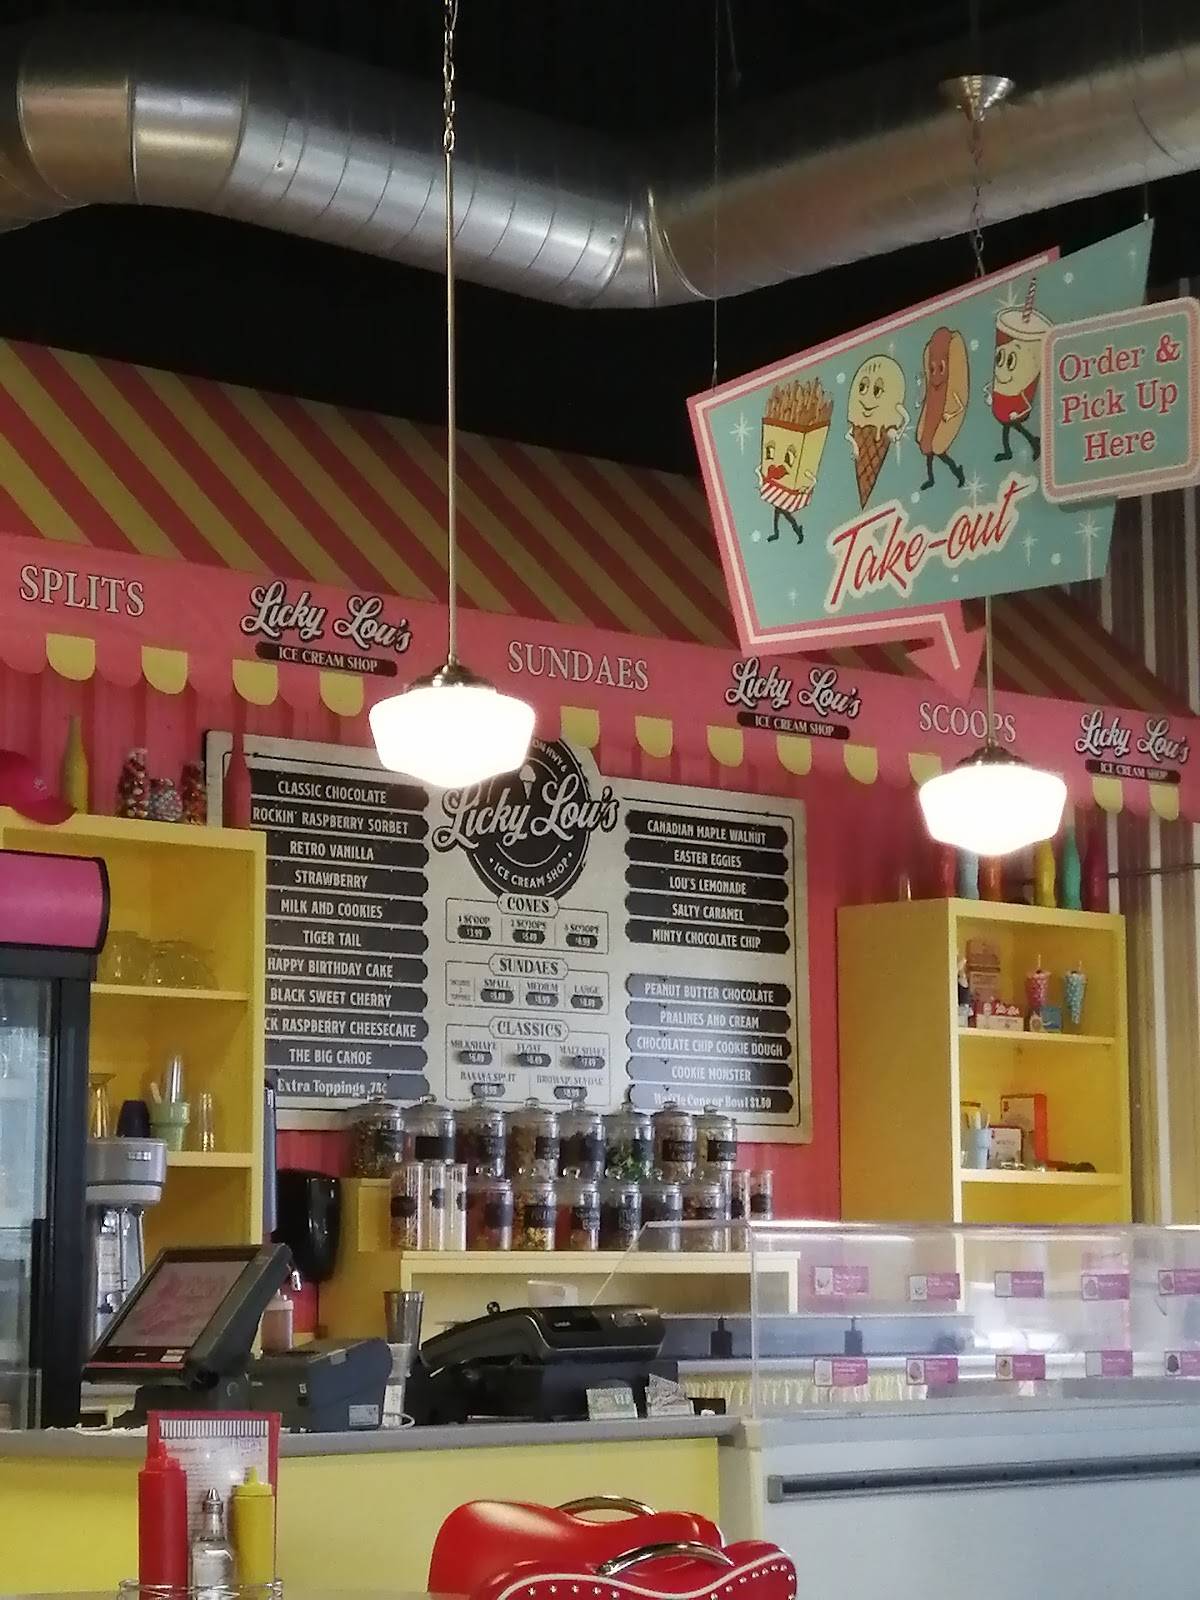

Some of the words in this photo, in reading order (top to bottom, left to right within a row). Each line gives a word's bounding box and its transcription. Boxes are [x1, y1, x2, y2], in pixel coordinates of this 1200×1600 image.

[1058, 344, 1145, 383] Order
[1155, 334, 1181, 363] &
[1061, 388, 1126, 424] Pick
[1136, 379, 1179, 414] Up
[1084, 430, 1156, 462] Here
[827, 478, 1033, 609] Take-out
[19, 564, 145, 617] SPLITS
[240, 580, 328, 641] Licky
[332, 595, 413, 653] Lou's
[279, 647, 298, 660] ICE
[302, 650, 344, 667] CREAM
[347, 657, 378, 673] SHOP
[508, 641, 648, 691] SUNDAES
[725, 657, 793, 709] Licky
[797, 668, 862, 718] Lou's
[755, 715, 769, 727] ICE
[773, 718, 808, 732] CREAM
[809, 723, 834, 737] SHOP
[919, 701, 1017, 743] SCOOPS
[1074, 709, 1131, 759] Licky
[1136, 718, 1190, 764] Lou's
[1100, 762, 1113, 773] ICE
[1115, 763, 1146, 778] CREAM
[1146, 767, 1168, 780] SHOP
[278, 781, 322, 798] CLASSIC
[325, 786, 387, 804] CHOCOLATE
[252, 807, 298, 823] ROCKIN'
[302, 812, 364, 830] RASPBERRY
[368, 818, 409, 835] SORBET
[432, 784, 531, 852] Licky
[530, 773, 619, 841] Lou's
[647, 820, 694, 837] CANADIAN
[697, 826, 727, 840] MAPLE
[730, 829, 767, 845] WALNUT
[289, 841, 326, 856] RETRO
[330, 844, 374, 861] VANILLA
[674, 849, 708, 865] EASTER
[711, 852, 742, 868] EGGIES
[295, 869, 368, 888] STRAWBERRY
[493, 862, 509, 880] ICE
[511, 874, 545, 888] CREAM
[546, 857, 569, 882] SHOP
[669, 876, 696, 890] LOU'S
[699, 879, 746, 895] LEMONADE
[281, 899, 307, 914] MILK
[311, 901, 334, 916] AND
[337, 903, 383, 919] COOKIES
[507, 896, 550, 913] CONES
[672, 903, 699, 918] SALTY
[702, 906, 745, 921] CARAMEL
[464, 915, 490, 925] SCOOP
[303, 930, 335, 945] TIGER
[338, 932, 362, 947] TAIL
[652, 928, 682, 942] MINTY
[685, 931, 737, 947] CHOCOLATE
[740, 935, 761, 949] CHIP
[267, 957, 305, 972] HAPPY
[308, 961, 362, 976] BIRTHDAY
[365, 964, 393, 978] CAKE
[499, 958, 559, 975] SUNDAES
[270, 987, 306, 1002] BLACK
[309, 990, 346, 1005] SWEET
[350, 992, 392, 1007] CHERRY
[644, 982, 680, 998] PEANUT
[684, 984, 719, 1000] BUTTER
[722, 988, 774, 1003] CHOCOLATE
[282, 1018, 347, 1034] RASPBERRY
[350, 1021, 417, 1038] CHEESECAKE
[497, 1020, 562, 1038] CLASSICS
[660, 1011, 704, 1026] PRALINES
[707, 1013, 726, 1027] AND
[729, 1015, 759, 1029] CREAM
[289, 1049, 311, 1063] THE
[314, 1050, 333, 1063] BIG
[336, 1051, 373, 1065] CANOE
[636, 1036, 689, 1051] CHOCOLATE
[692, 1039, 714, 1052] CHIP
[716, 1041, 749, 1055] COOKIE
[751, 1043, 783, 1057] DOUGH
[671, 1065, 705, 1079] COOKIE
[708, 1068, 752, 1081] MONSTER
[277, 1079, 310, 1092] Extra
[313, 1079, 365, 1097] Toppings
